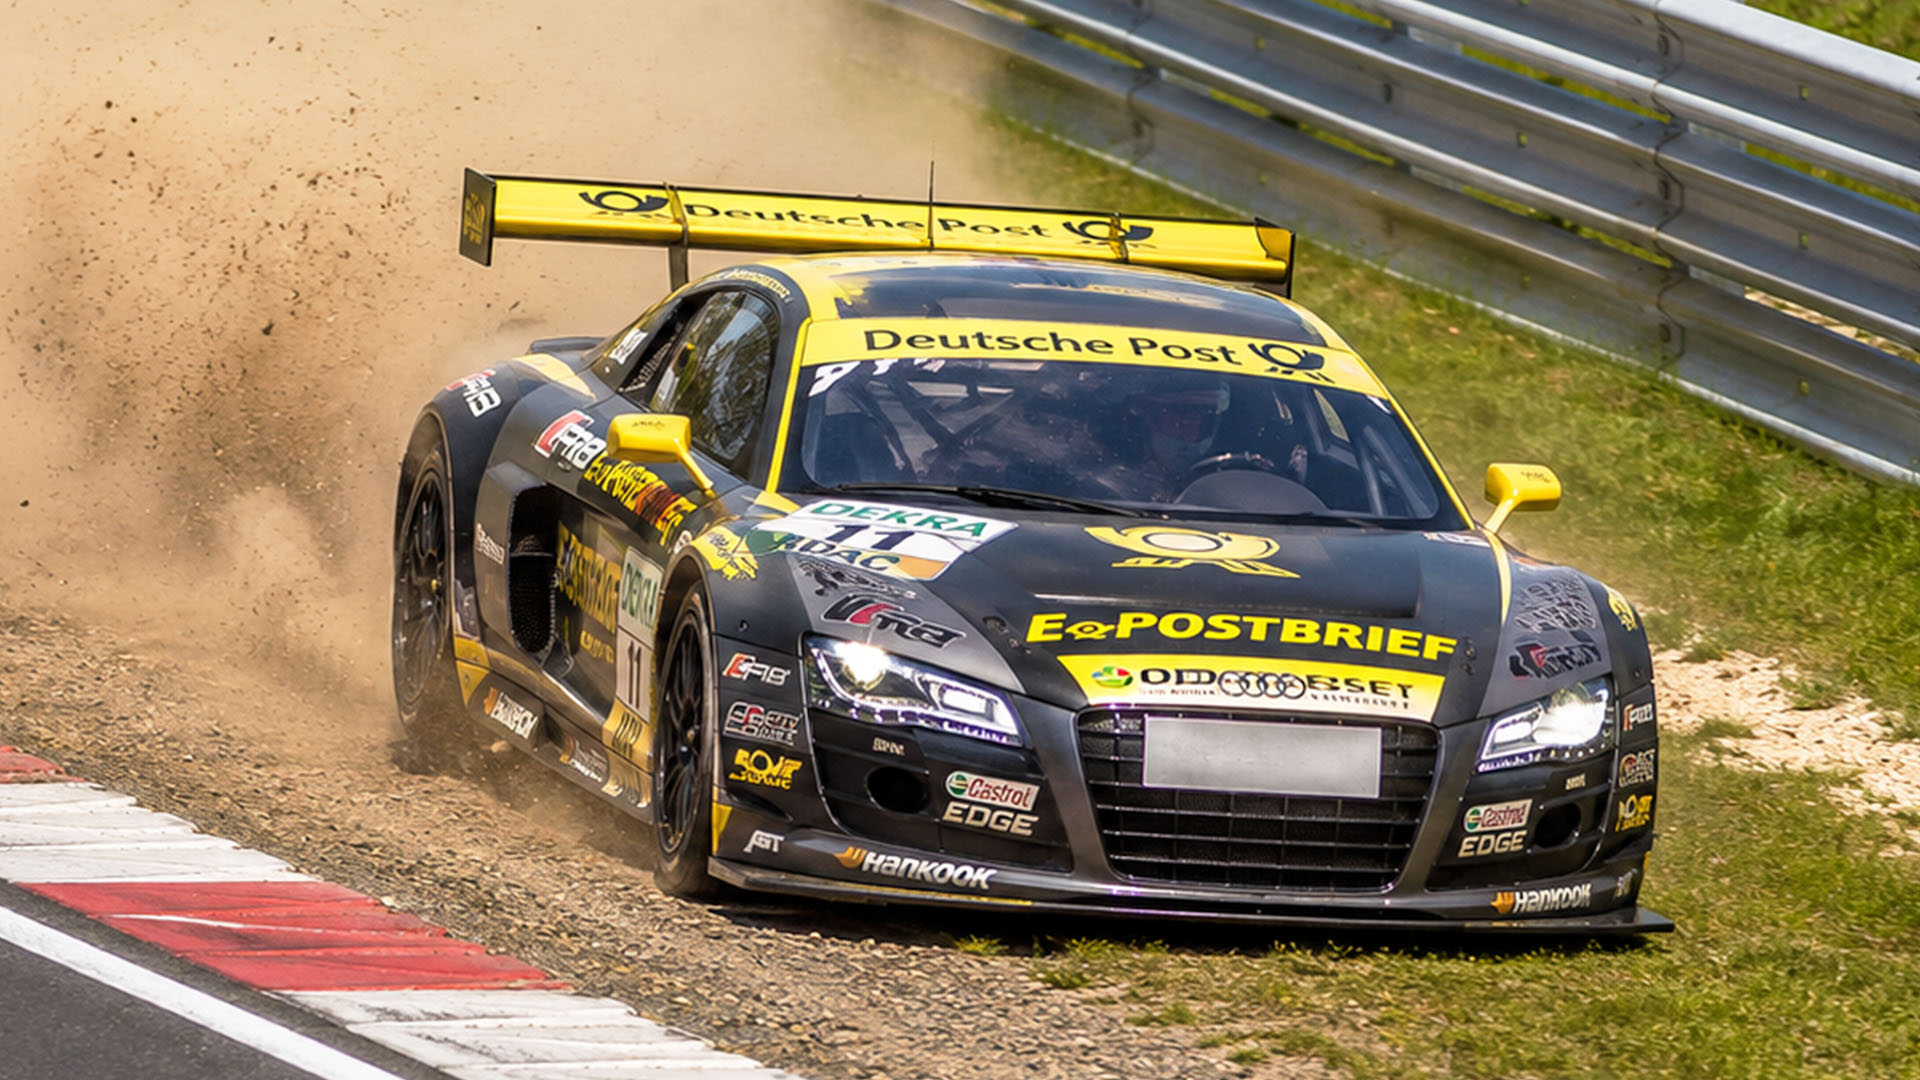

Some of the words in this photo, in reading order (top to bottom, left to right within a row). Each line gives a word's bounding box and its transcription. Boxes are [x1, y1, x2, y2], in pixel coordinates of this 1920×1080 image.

[683, 203, 925, 229] Deutsche
[937, 218, 1052, 238] Post
[863, 329, 1115, 355] Deutsche
[1128, 337, 1243, 366] Post
[810, 502, 990, 538] DEKRA
[824, 523, 919, 551] 11
[968, 778, 1031, 809] Castrol
[942, 801, 1039, 836] EDGE
[1458, 830, 1527, 858] EDGE
